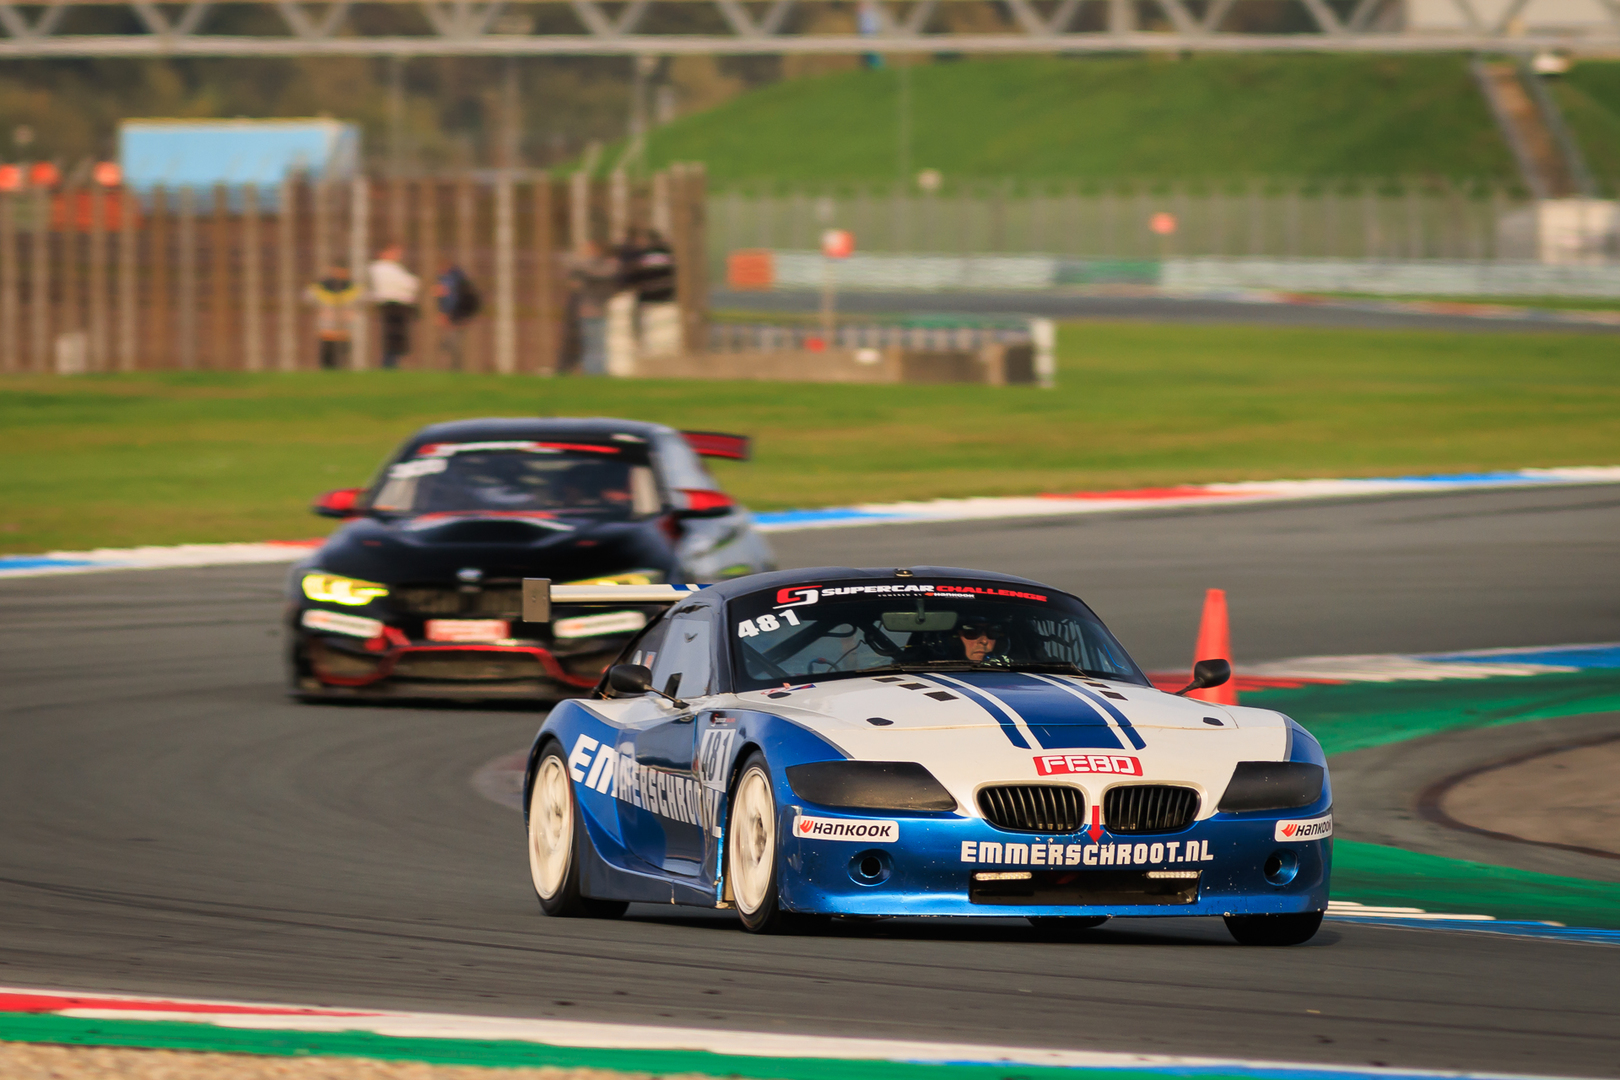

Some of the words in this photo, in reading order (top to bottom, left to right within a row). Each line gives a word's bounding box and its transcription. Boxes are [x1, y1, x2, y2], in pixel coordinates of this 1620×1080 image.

[822, 585, 934, 597] SUPERCAR
[936, 585, 1047, 602] CHALLENGE
[738, 609, 800, 638] 481
[701, 731, 731, 782] 481
[1041, 756, 1135, 774] FEBO
[961, 840, 1213, 865] EMMERSCHROOT.NL
